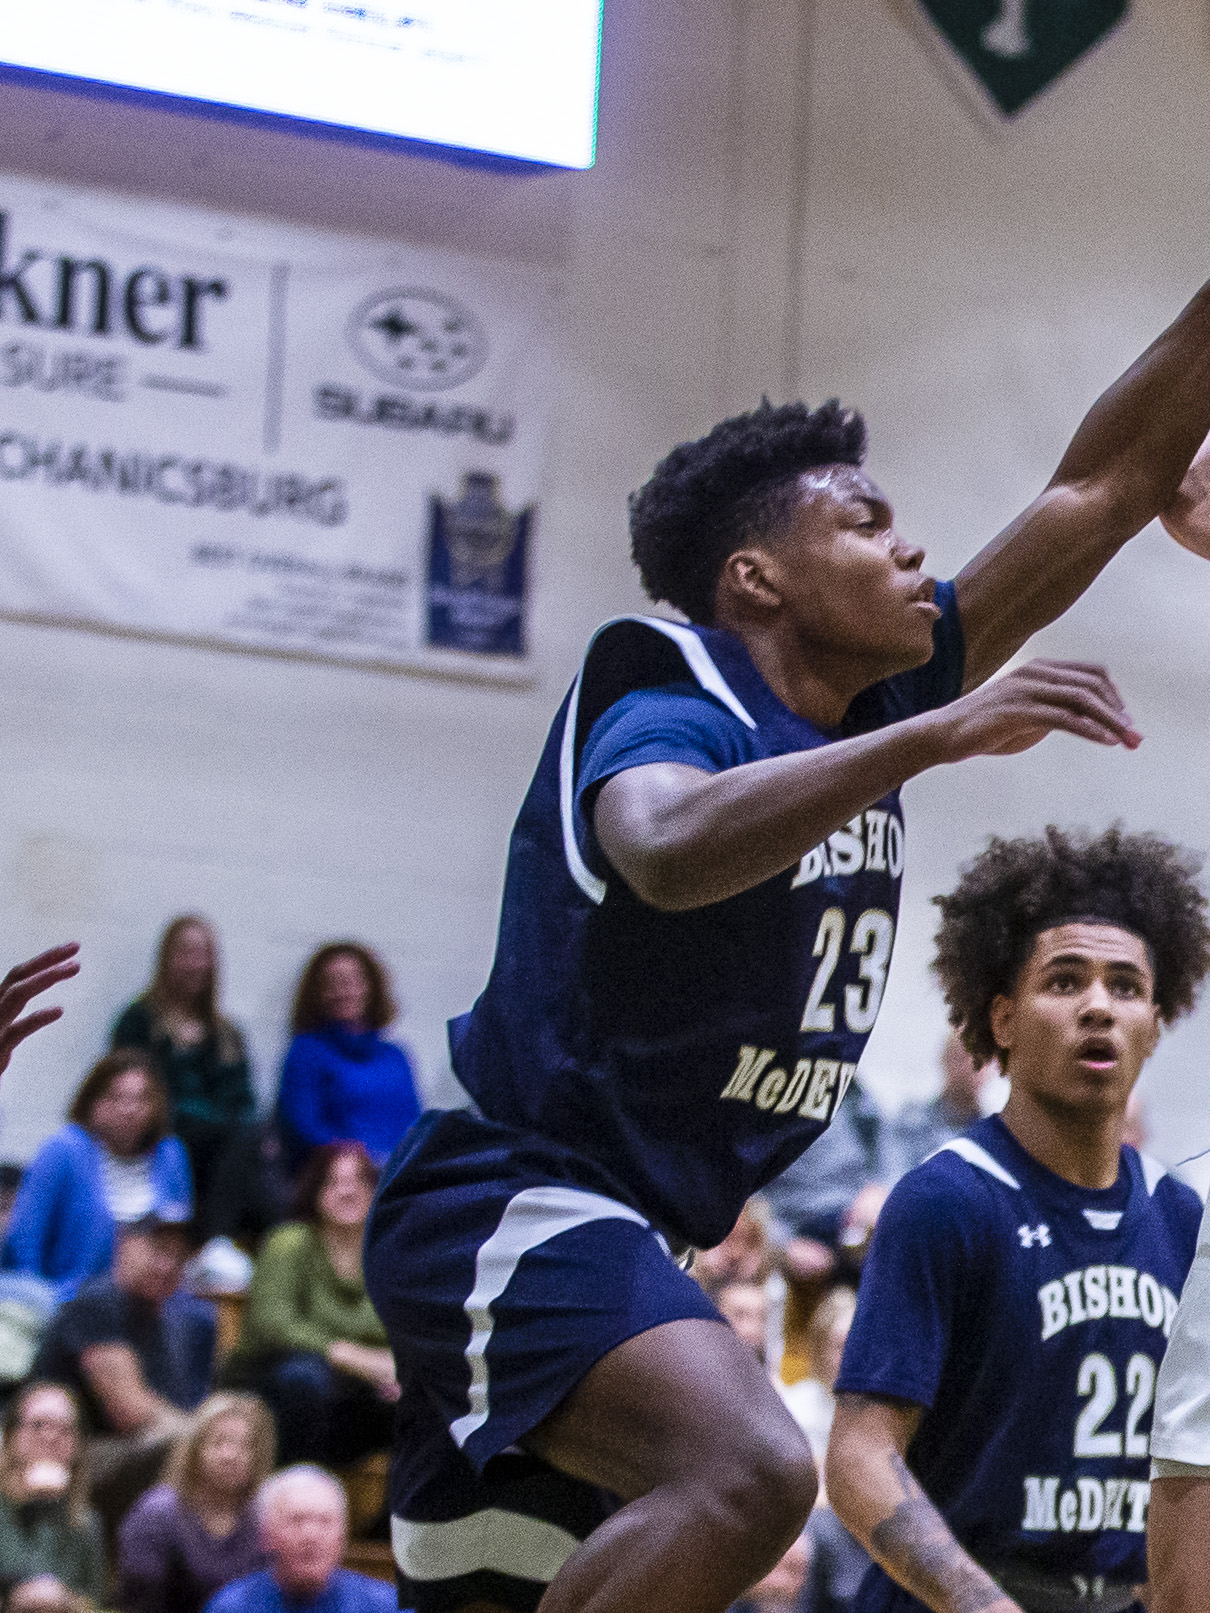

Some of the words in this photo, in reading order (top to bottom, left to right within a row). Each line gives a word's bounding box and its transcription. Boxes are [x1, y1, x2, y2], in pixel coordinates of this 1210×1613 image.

[313, 383, 515, 445] SUBARU
[800, 906, 895, 1034] 23
[1073, 1353, 1156, 1459] 22
